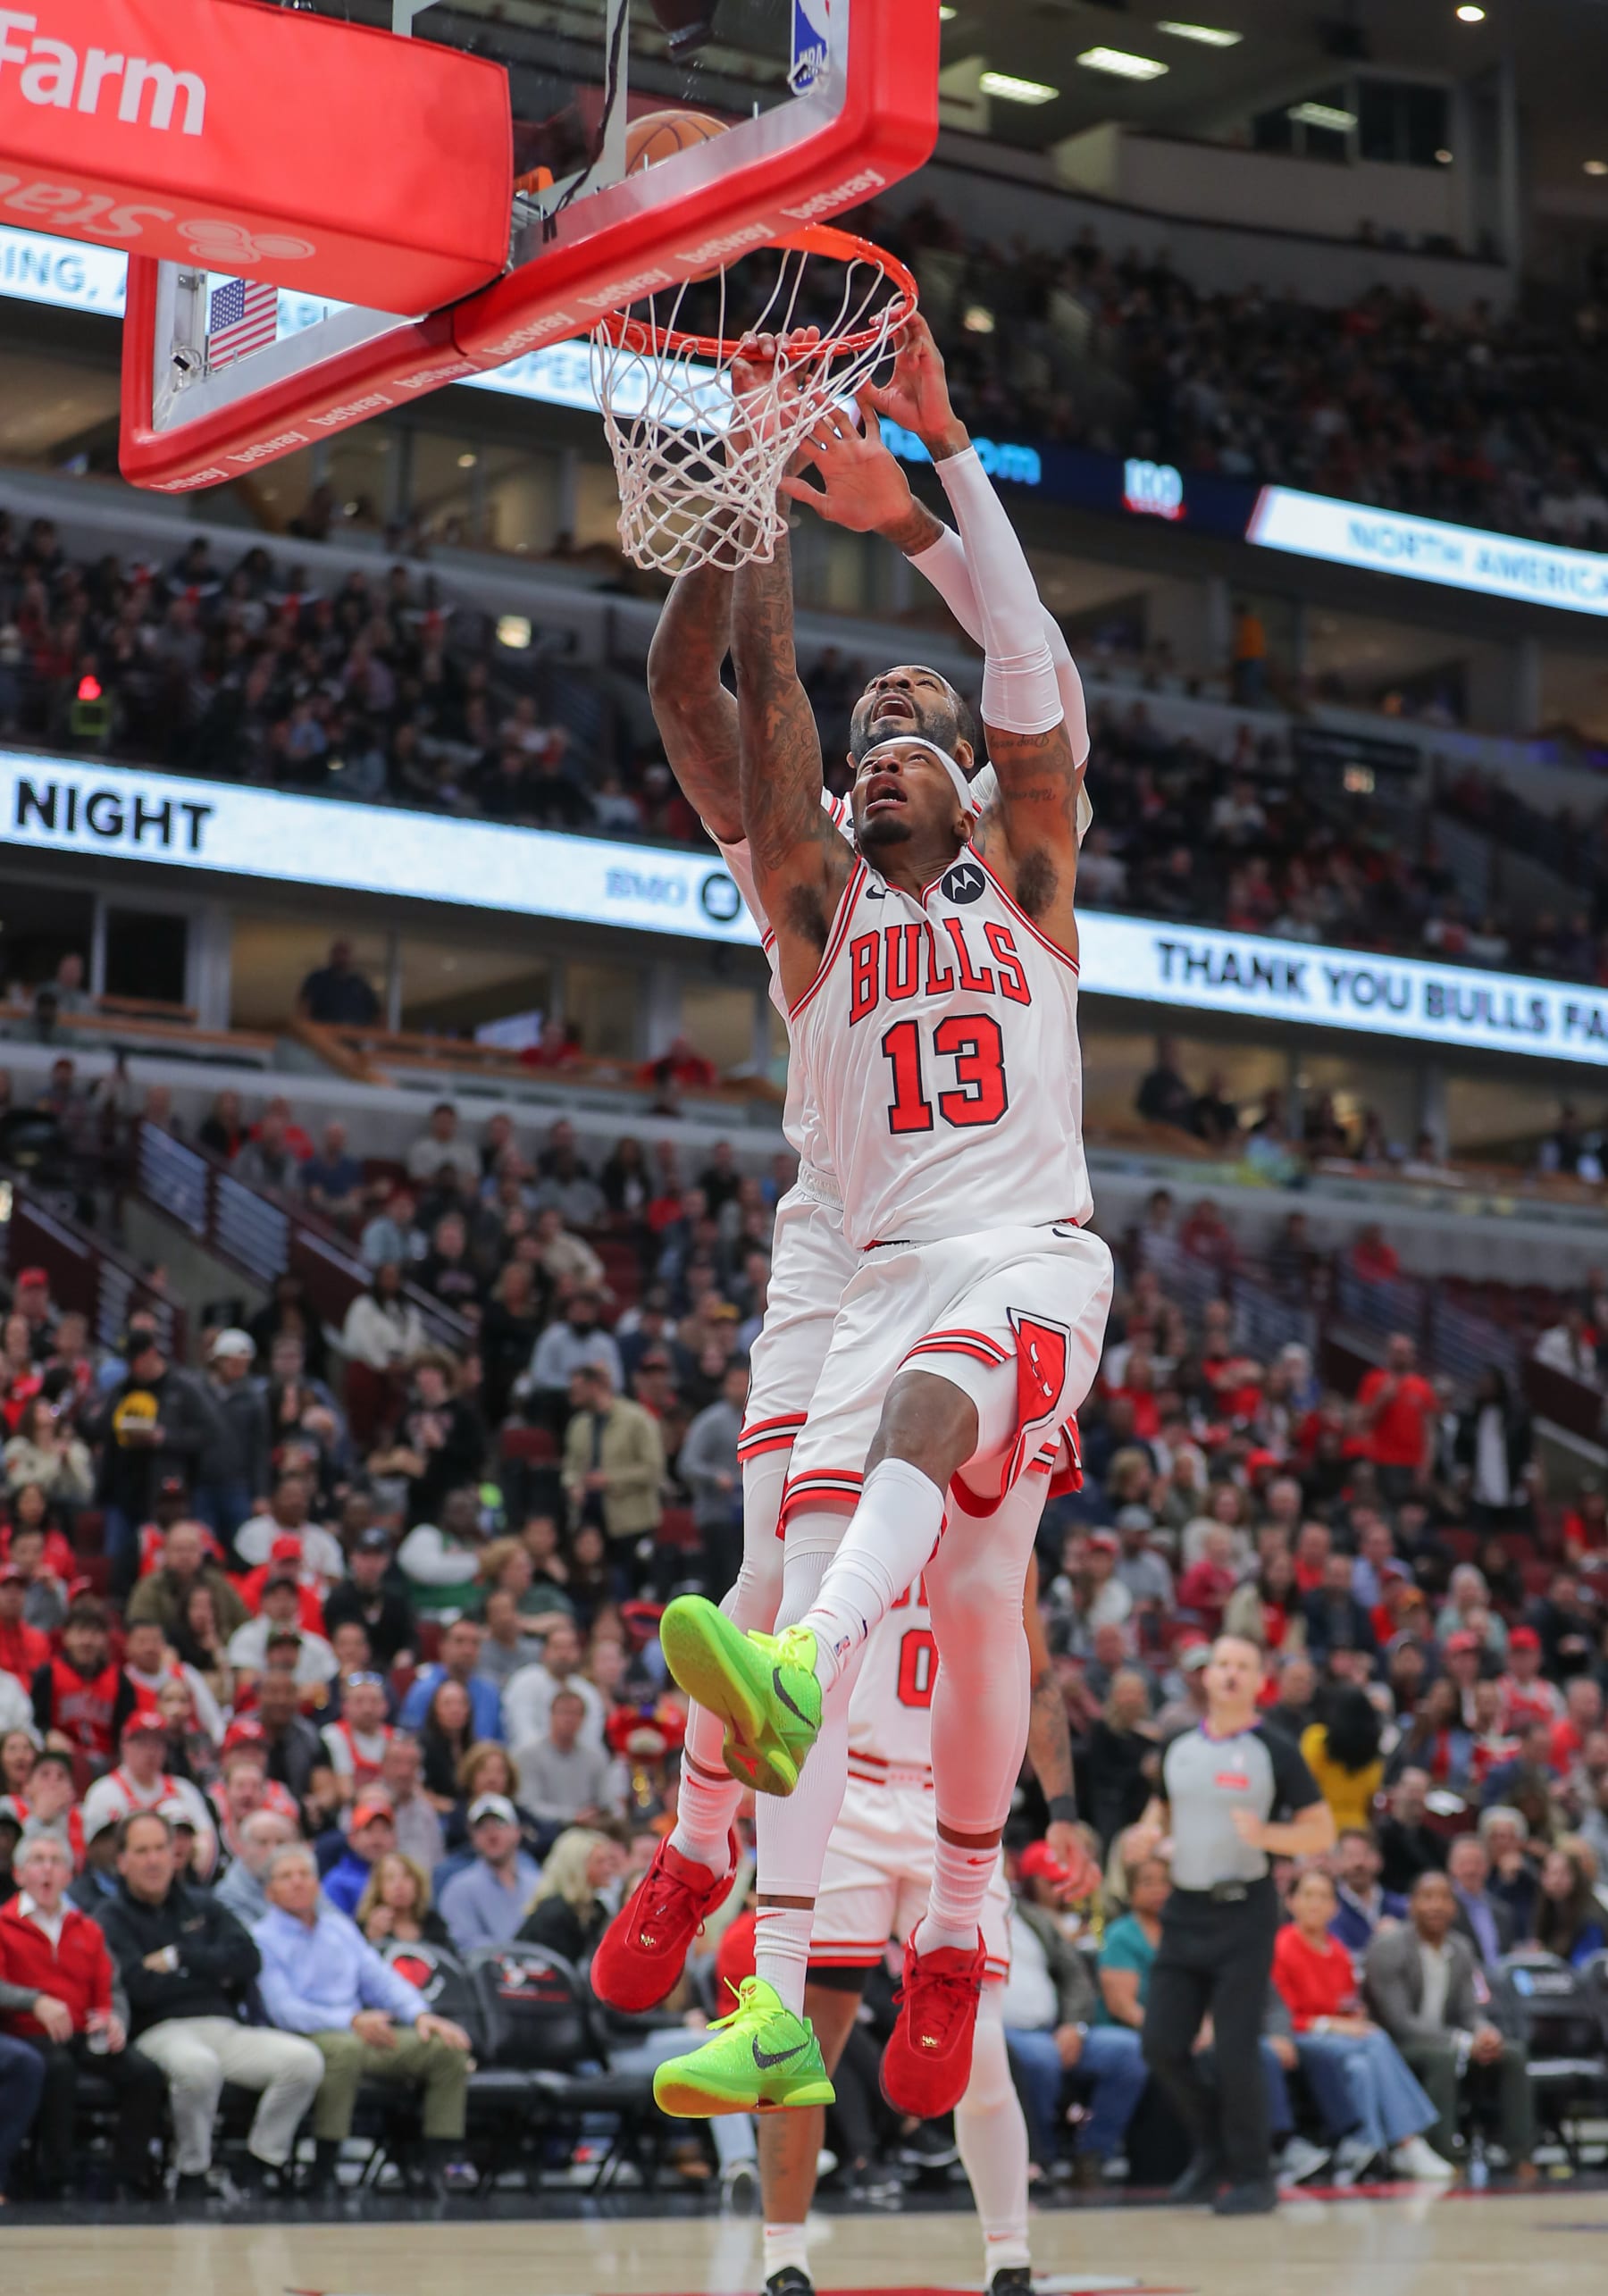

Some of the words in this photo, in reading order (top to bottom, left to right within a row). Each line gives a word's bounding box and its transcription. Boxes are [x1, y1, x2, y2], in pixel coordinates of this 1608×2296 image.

[0, 8, 207, 136] Farm
[0, 245, 98, 301] ING,
[150, 465, 229, 490] betway
[227, 430, 309, 463] betway
[308, 392, 394, 426] betway
[394, 361, 481, 390] betway
[483, 312, 575, 356] betway
[579, 268, 672, 306] betway
[675, 223, 775, 264] betway
[779, 168, 885, 220] betway
[15, 777, 216, 851] NIGHT
[850, 918, 1032, 1027] BULLS
[1157, 941, 1307, 995] THANK
[1325, 968, 1410, 1010] YOU
[1427, 983, 1549, 1035] BULLS
[882, 1013, 1009, 1135] 13
[897, 1629, 939, 1710] 0
